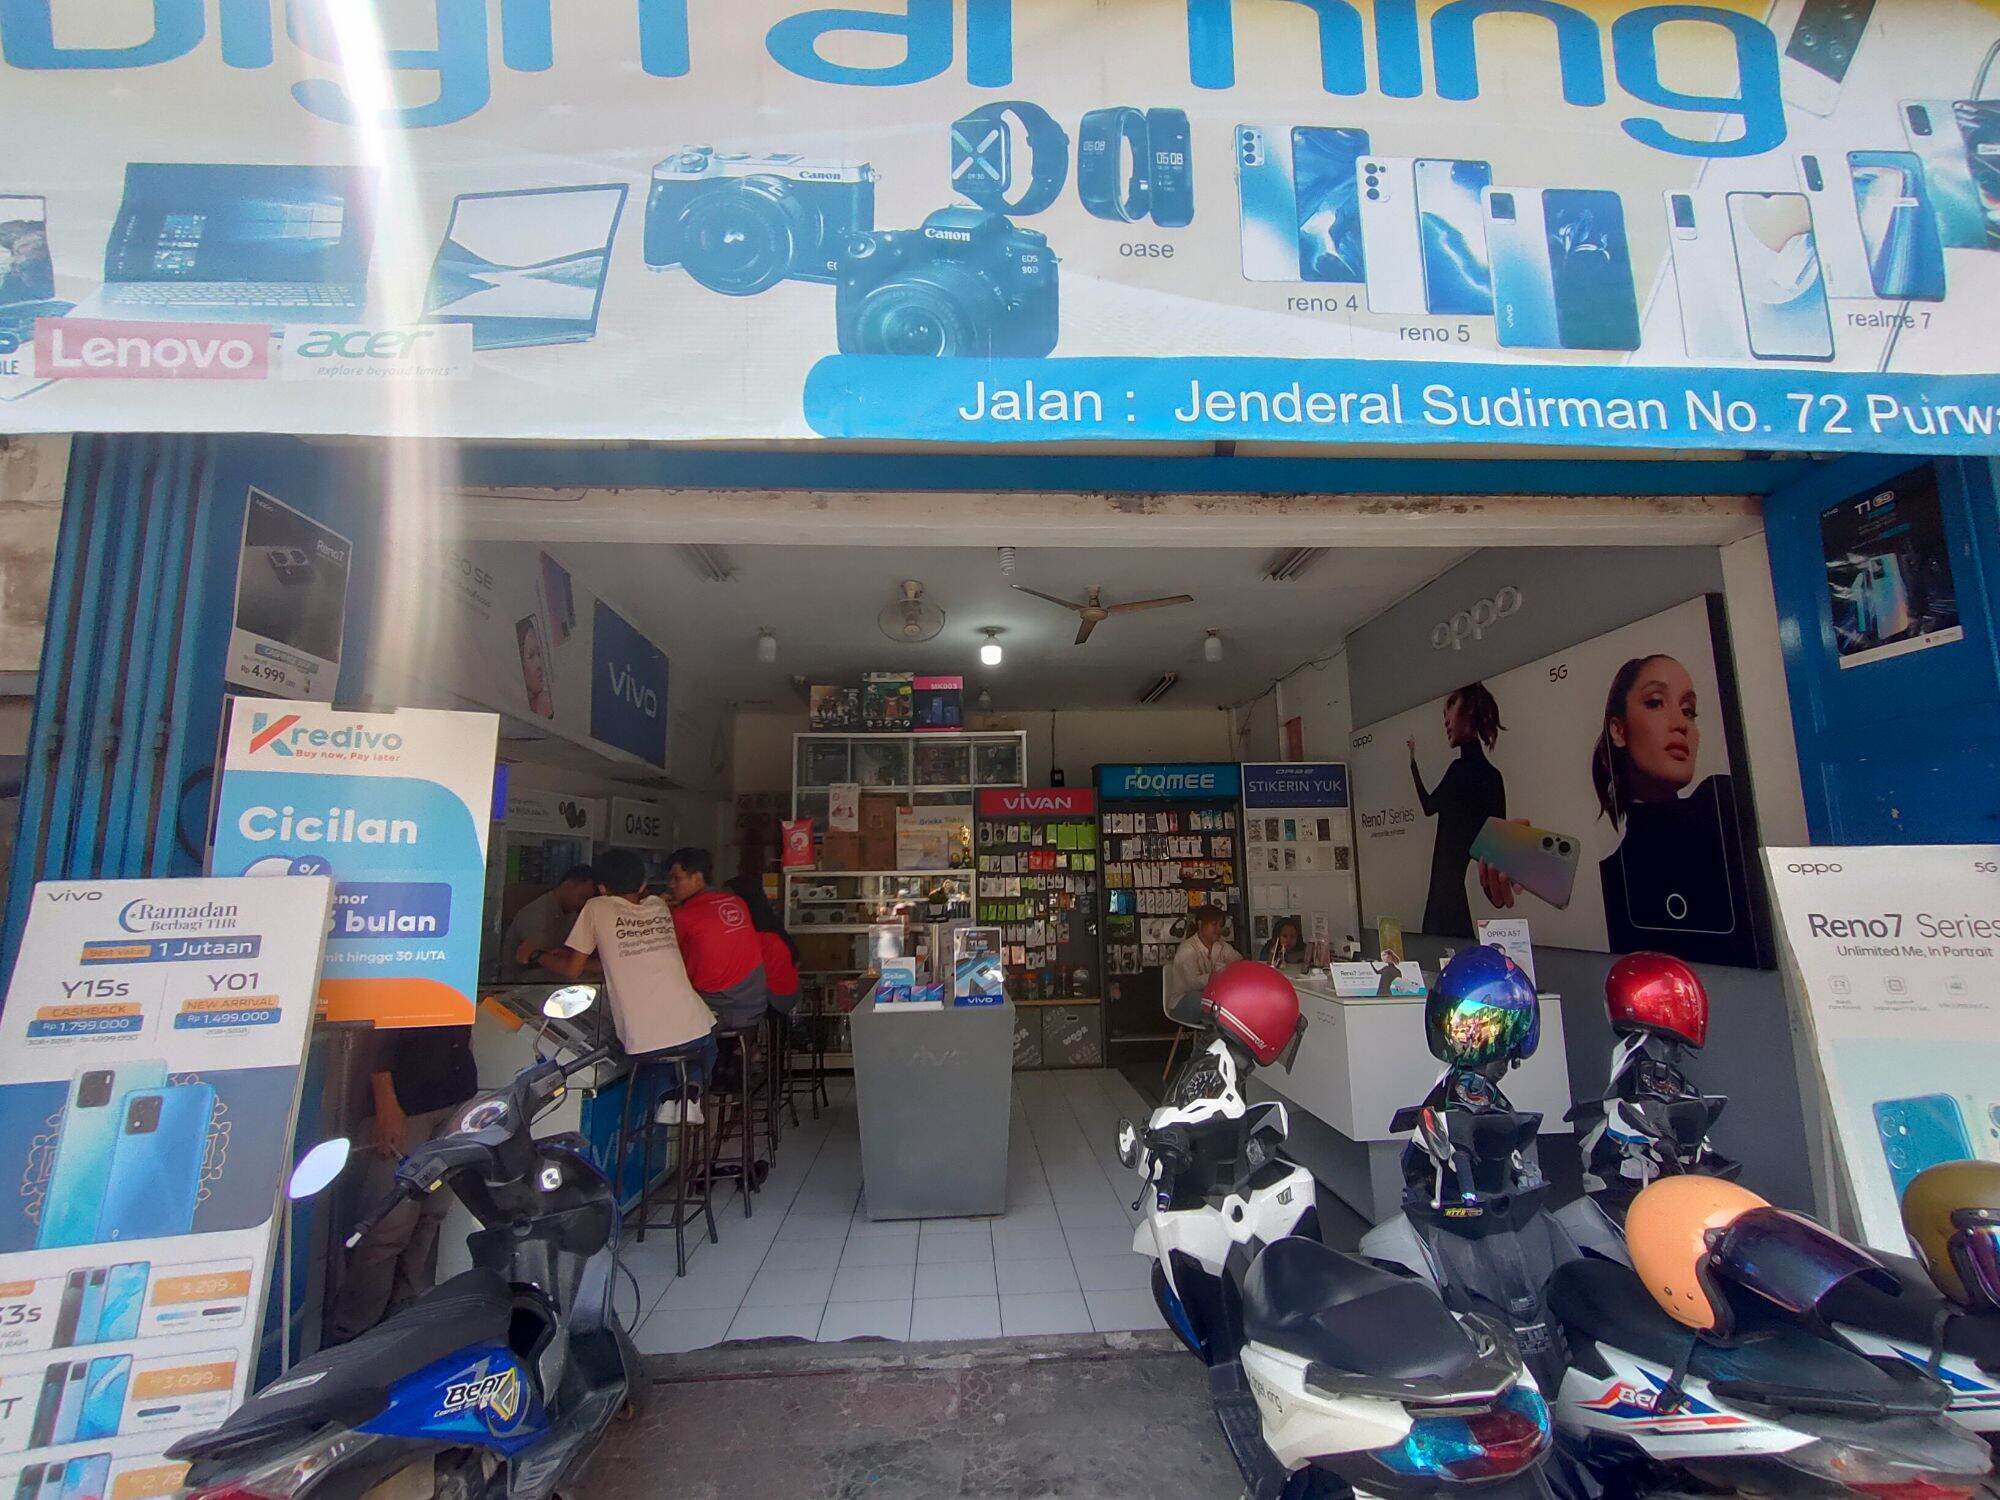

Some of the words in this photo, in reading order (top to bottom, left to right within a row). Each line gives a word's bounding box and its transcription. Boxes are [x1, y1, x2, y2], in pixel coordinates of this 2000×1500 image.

[799, 170, 841, 180] Canon
[924, 228, 971, 242] Canon
[1021, 255, 1038, 263] EOS
[1119, 242, 1175, 258] oase
[1287, 296, 1339, 312] reno
[1345, 294, 1358, 312] 4
[1848, 310, 1915, 329] realme
[1920, 312, 1932, 329] 7
[1400, 326, 1451, 343] reno
[1457, 323, 1470, 343] 5
[52, 328, 254, 370] Lenovo
[297, 329, 434, 359] acer
[317, 365, 364, 378] explore
[958, 381, 1102, 423] Jalan
[1174, 381, 1402, 426] Jenderal
[1422, 386, 1669, 432] Sudirman
[1686, 391, 1772, 433] No.
[1788, 394, 1852, 435] 72
[1866, 394, 2000, 436] Purw
[1432, 586, 1522, 651] oppo
[251, 664, 286, 683] 4.999
[1549, 664, 1569, 683] 5G
[608, 662, 658, 718] vivo
[249, 712, 403, 757] Kredivo
[1352, 732, 1374, 750] oppo
[295, 749, 318, 761] Buy
[320, 751, 348, 763] now,
[350, 751, 371, 763] Pay
[374, 752, 401, 763] later
[1248, 780, 1311, 793] STIKERIN
[1315, 780, 1342, 792] YUK
[238, 805, 419, 846] Cicilan
[625, 812, 661, 837] OASE
[1361, 809, 1387, 828] Reno7
[1388, 808, 1416, 825] Series
[1787, 863, 1843, 876] oppo
[1975, 862, 1999, 873] 5G
[48, 890, 103, 902] vivo
[139, 902, 238, 921] Ramadan
[150, 919, 204, 932] Berbagi
[206, 919, 237, 929] THR
[345, 909, 437, 933] bulan
[1808, 913, 1903, 938] Reno7
[1486, 930, 1506, 938] OPPO
[159, 942, 169, 956] 1
[175, 941, 252, 956] Jutaan
[347, 952, 393, 964] hingga
[396, 951, 413, 961] 30
[415, 950, 446, 961] JUTA
[1837, 945, 1900, 958] Unlimited
[1902, 946, 1927, 958] Me,
[1929, 946, 1942, 957] In
[1944, 946, 1995, 958] Portrait
[62, 979, 130, 1001] Y15s
[207, 972, 260, 993] Y01
[52, 1005, 127, 1018] CASHBACK
[186, 1000, 219, 1010] NEW
[221, 998, 274, 1009] ARRIVAL
[43, 1023, 57, 1031] Rp
[60, 1019, 129, 1032] 1.799.000
[187, 1015, 200, 1023] Rp
[203, 1011, 270, 1024] 1.499.000
